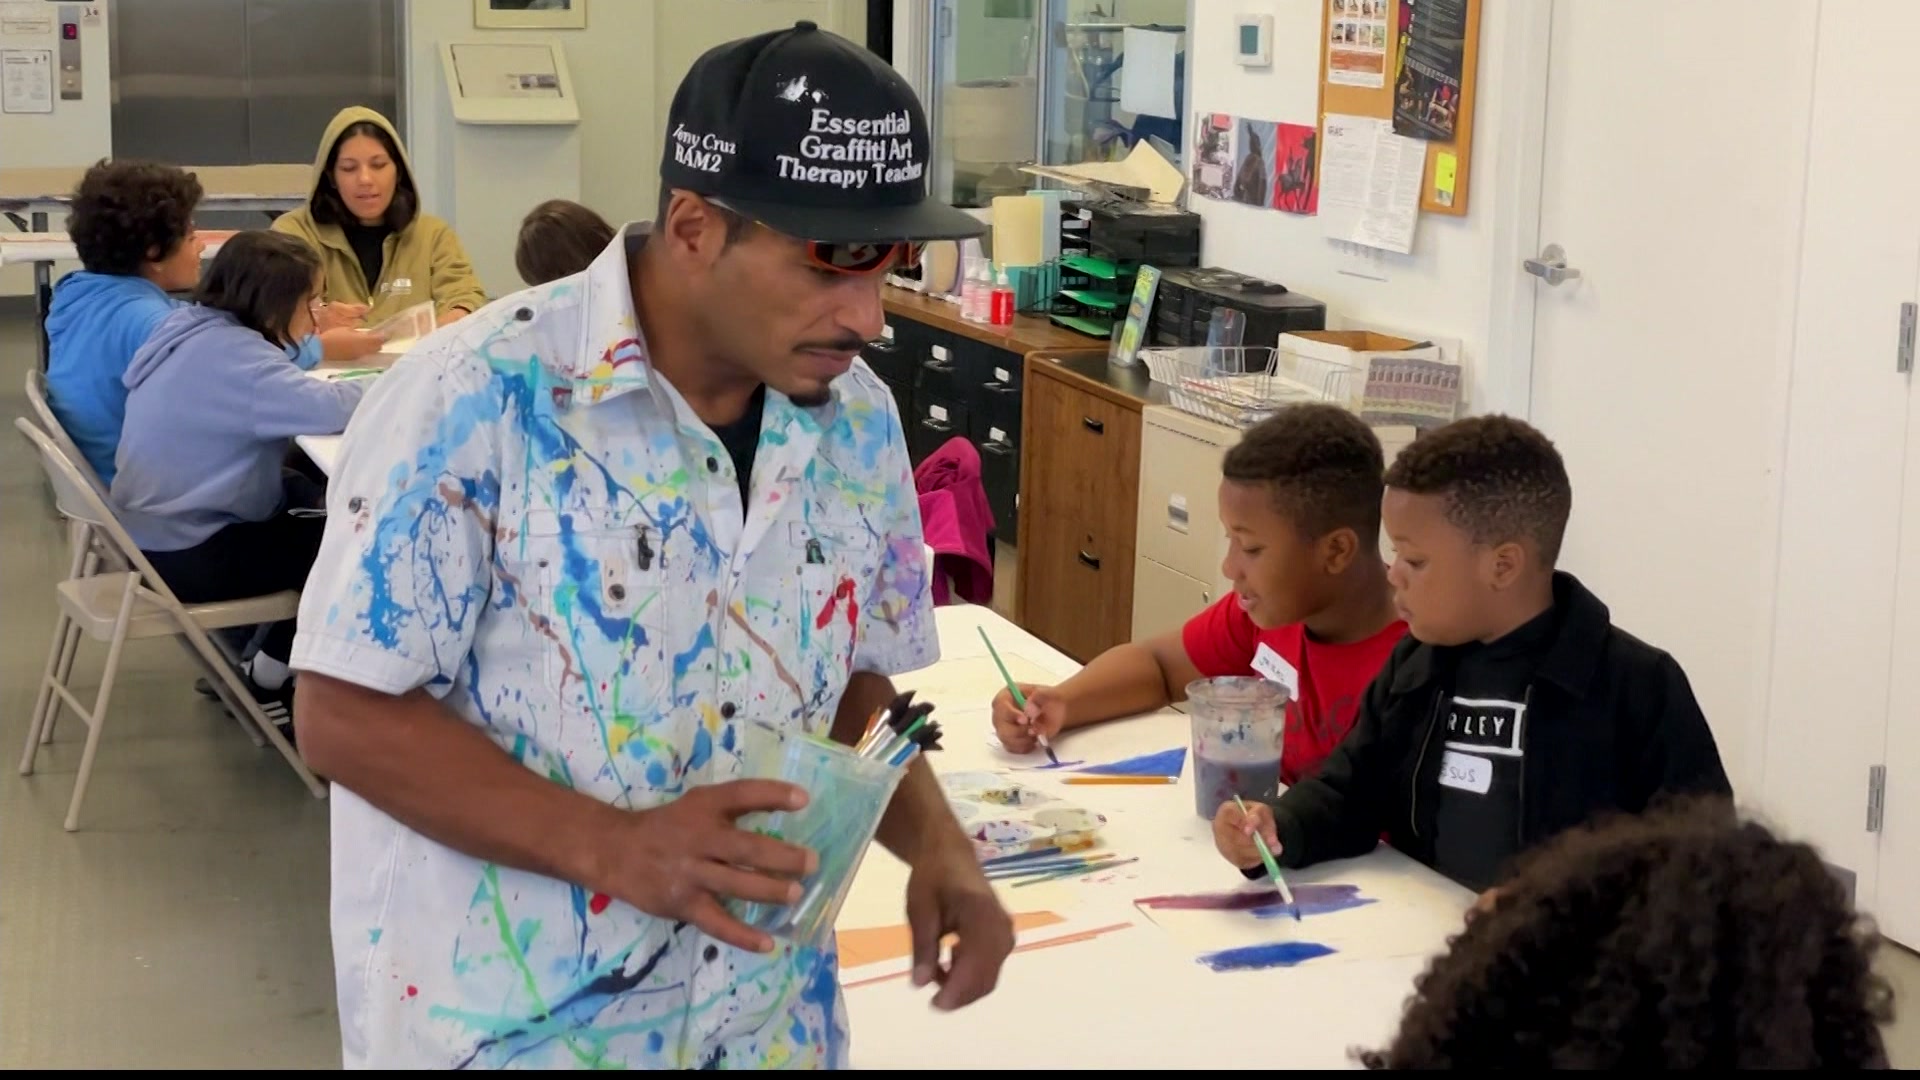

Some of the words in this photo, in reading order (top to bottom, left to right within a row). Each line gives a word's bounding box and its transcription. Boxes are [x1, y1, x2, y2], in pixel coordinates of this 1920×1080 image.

[809, 108, 911, 136] Essential
[702, 133, 736, 154] Cruz
[800, 135, 886, 162] Graffiti
[888, 137, 913, 160] Art
[675, 142, 722, 173] RAM2
[776, 154, 869, 188] Therapy
[1447, 712, 1505, 737] RLEY
